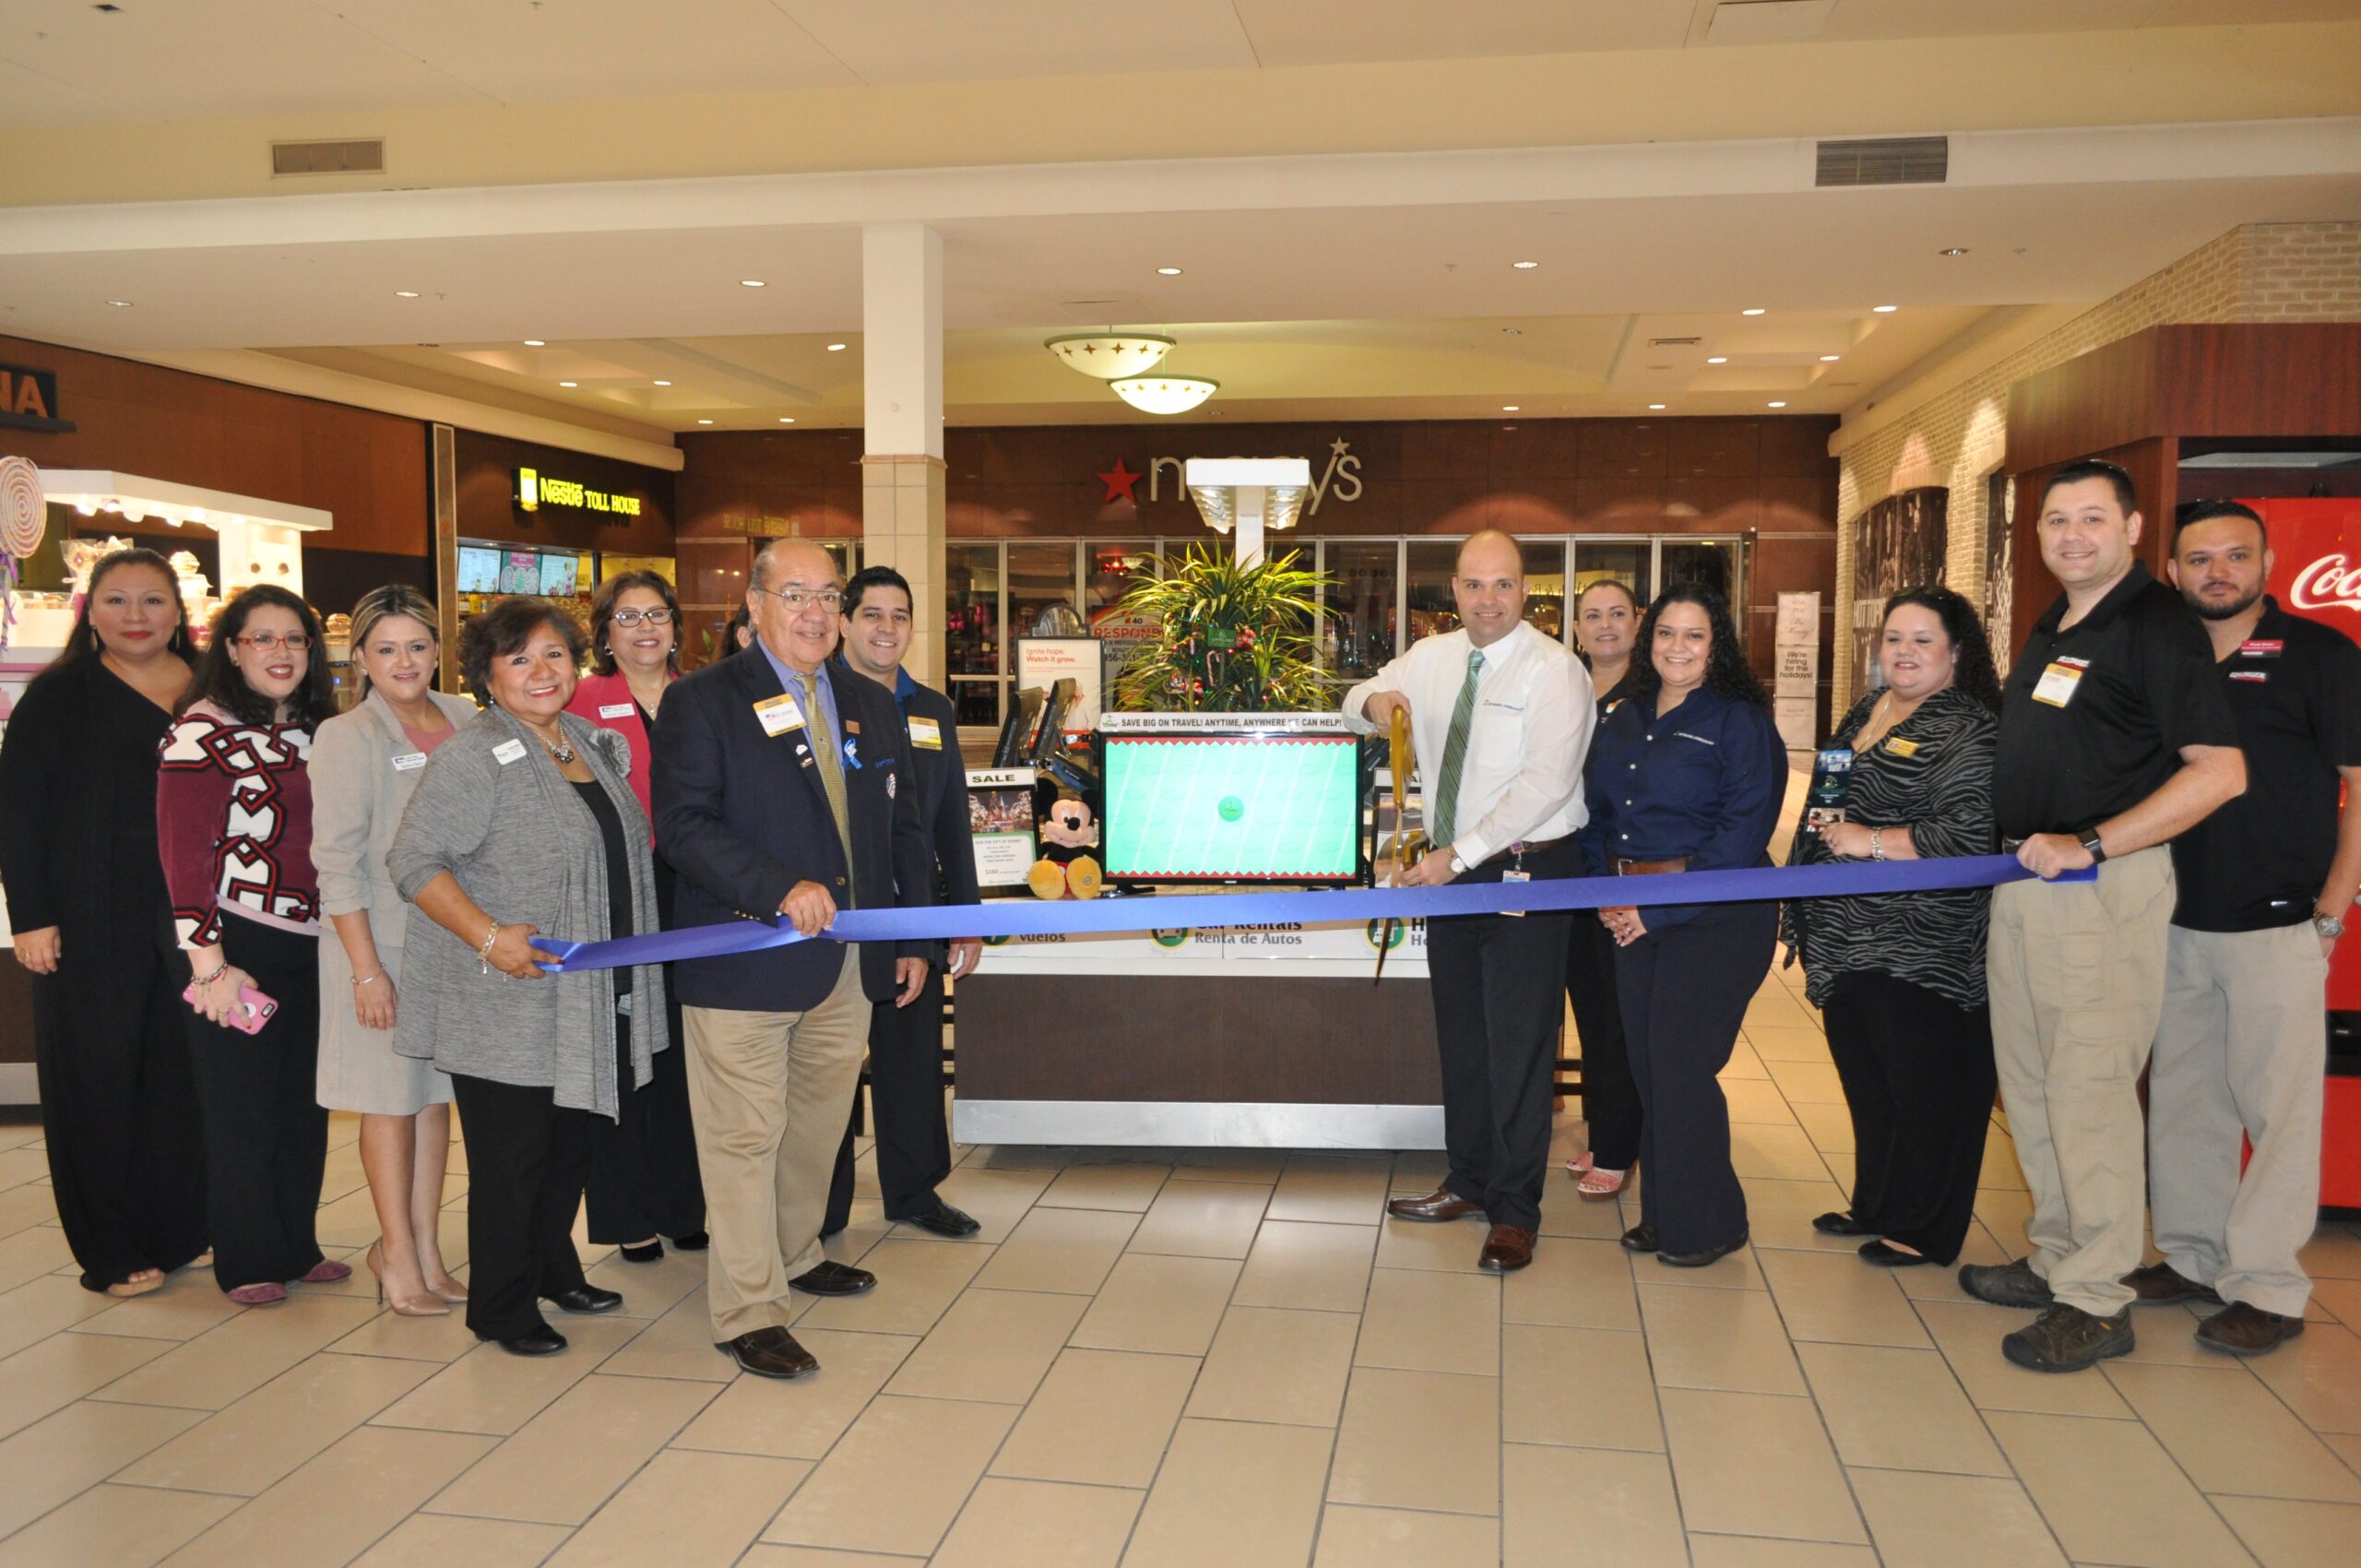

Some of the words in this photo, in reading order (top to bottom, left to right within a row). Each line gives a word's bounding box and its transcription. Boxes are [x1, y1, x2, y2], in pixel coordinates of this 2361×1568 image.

[1150, 436, 1362, 516] my's
[584, 490, 611, 511] TOLL
[611, 494, 641, 516] HOUSE
[2290, 553, 2361, 611] Coc
[1046, 647, 1065, 656] hope.
[1786, 658, 1808, 666] hiring
[1121, 719, 1141, 727] SAVE
[1143, 719, 1157, 727] BIG
[1158, 719, 1169, 727] ON
[1171, 719, 1204, 727] TRAVEL!
[1204, 719, 1241, 728] ANYTIME,
[1243, 719, 1286, 727] ANYWHERE
[1301, 719, 1319, 727] CAN
[1320, 719, 1342, 727] HELP!
[971, 774, 1016, 783] SALE
[1195, 932, 1236, 944] Renta
[1240, 932, 1257, 944] de
[1262, 933, 1302, 945] Autos
